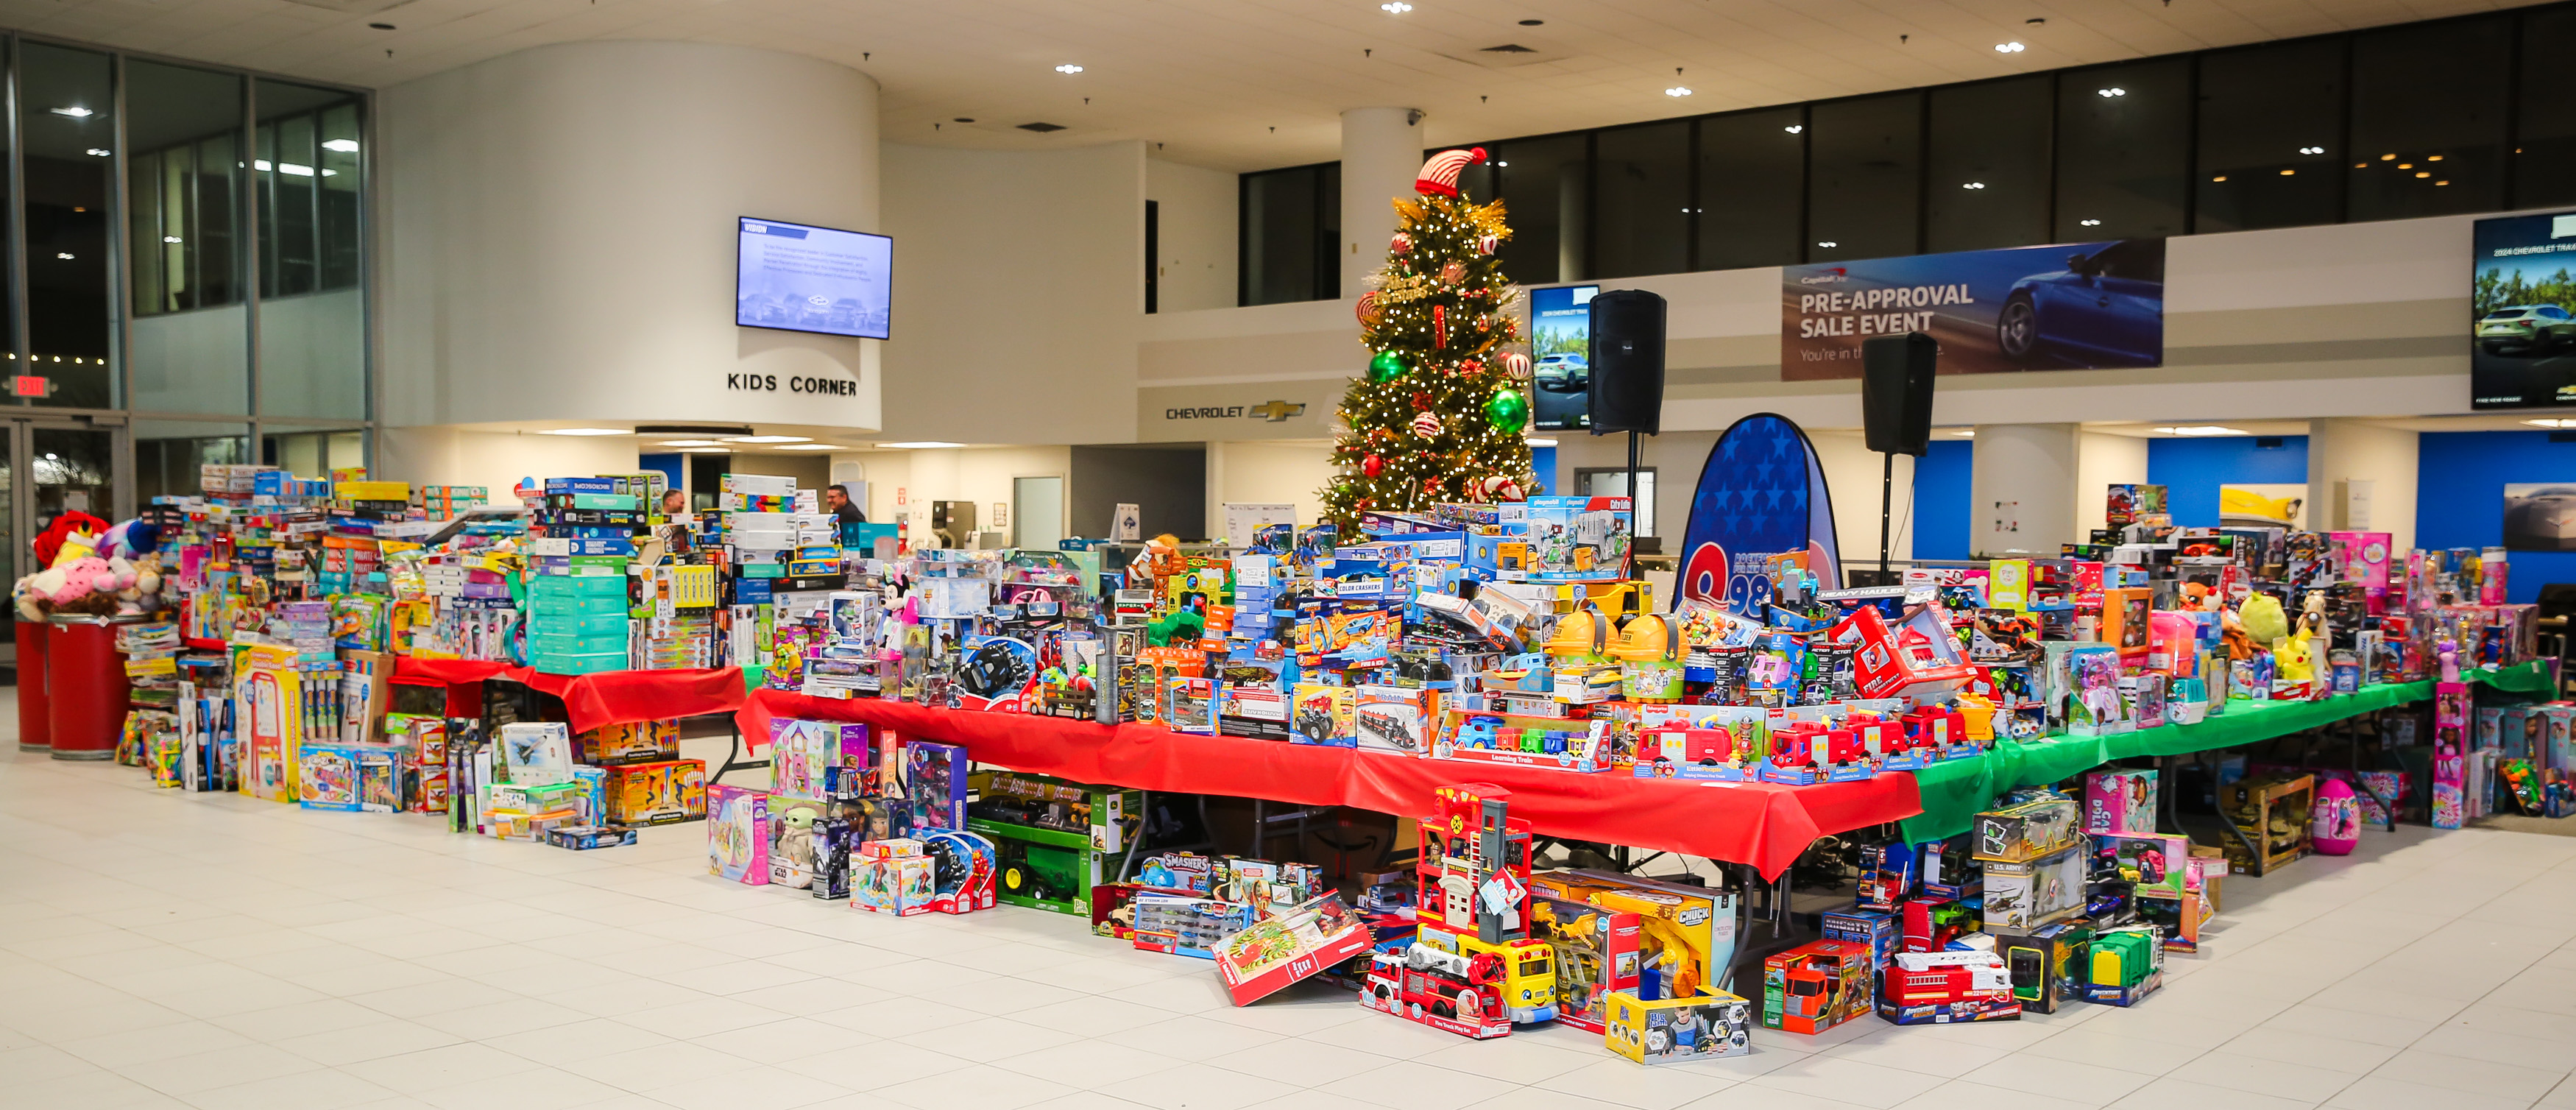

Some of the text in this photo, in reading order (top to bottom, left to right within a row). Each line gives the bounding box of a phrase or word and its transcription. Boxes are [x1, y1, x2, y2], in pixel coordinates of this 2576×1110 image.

[744, 223, 768, 234] VISION
[2513, 245, 2554, 255] CHEVROLET
[1801, 284, 1974, 314] PRE-APPROVAL
[1800, 311, 1935, 339] SALE EVENT
[1800, 347, 1836, 362] You're
[1839, 347, 1850, 359] in
[19, 378, 44, 395] EXIT
[728, 373, 857, 397] KIDS CORNER
[1166, 406, 1245, 420] CHEVROLET
[574, 482, 610, 490] MICROSCOPE
[1610, 499, 1630, 510] City Life
[355, 550, 375, 561] PIRATE
[355, 562, 374, 573] PIRATE
[1821, 587, 1906, 598] HEAVY HAULER
[1298, 601, 1321, 609] ADVENTURE
[1863, 675, 1883, 693] FIRE
[1873, 674, 1900, 693] DEPARTMENT
[1974, 682, 1989, 691] KID
[246, 686, 254, 694] 86
[1376, 693, 1404, 702] TRAIN
[1492, 754, 1517, 764] Learning
[1164, 853, 1208, 872] SMASHERS
[1494, 883, 1507, 899] KID
[1075, 899, 1087, 908] Big
[1679, 907, 1710, 923] CHUCK
[1825, 919, 1871, 933] MIGHTY
[1825, 929, 1872, 944] FLEET
[1363, 991, 1376, 1003] KID
[1903, 1005, 1937, 1017] ADVENTURE
[1999, 1007, 2019, 1016] ENGINE
[1650, 1012, 1666, 1022] Big
[1443, 1022, 1454, 1030] Truck
[1454, 1025, 1463, 1033] Play
[1649, 1019, 1669, 1029] farm
